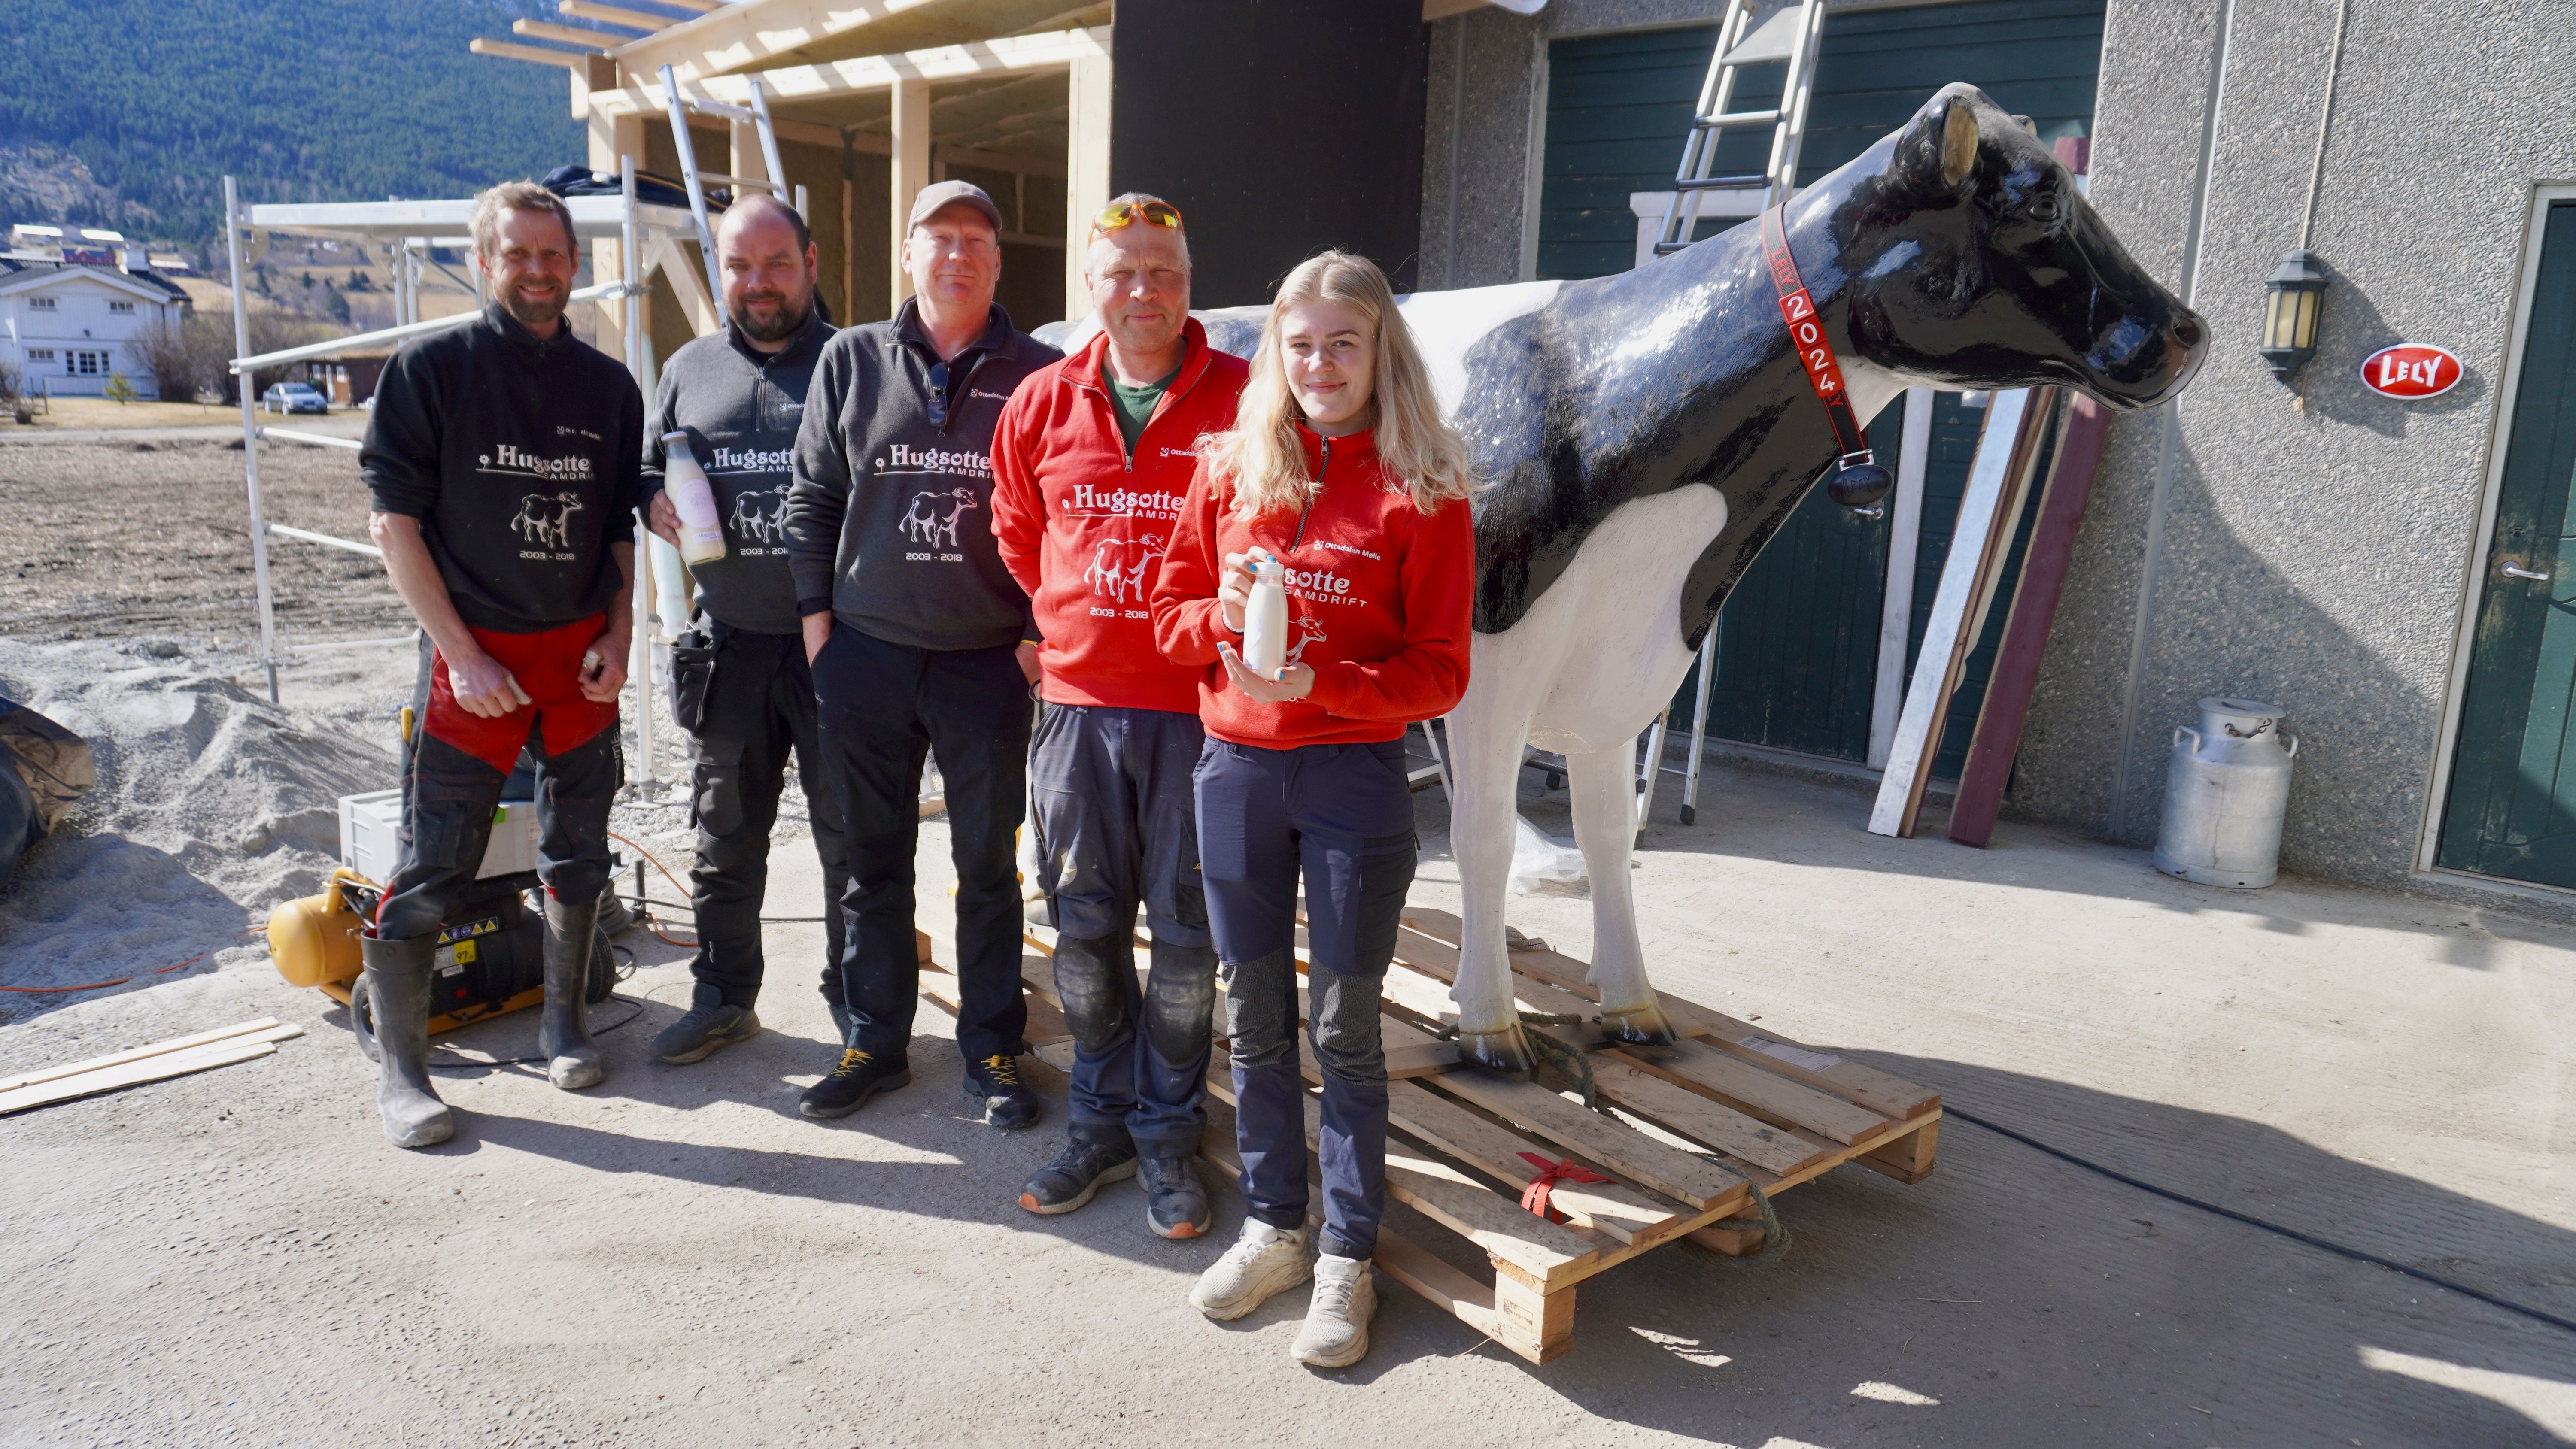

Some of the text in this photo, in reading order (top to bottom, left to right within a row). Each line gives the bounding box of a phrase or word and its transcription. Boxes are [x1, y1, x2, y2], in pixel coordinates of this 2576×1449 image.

[1771, 249, 1795, 285] LELY
[2379, 355, 2443, 388] LELY
[978, 391, 1005, 400] Ottadalen
[497, 444, 589, 473] Hugsotte
[712, 447, 794, 469] Hugsott
[890, 444, 991, 470] Hugsotte
[1073, 484, 1185, 512] Hugsotte
[519, 551, 546, 559] 2003
[1325, 542, 1381, 561] Ottadalen Mølle
[1284, 585, 1367, 607] SAMDRIFT
[1090, 606, 1115, 617] 2003
[1125, 610, 1148, 619] 2018
[457, 951, 468, 962] 97
